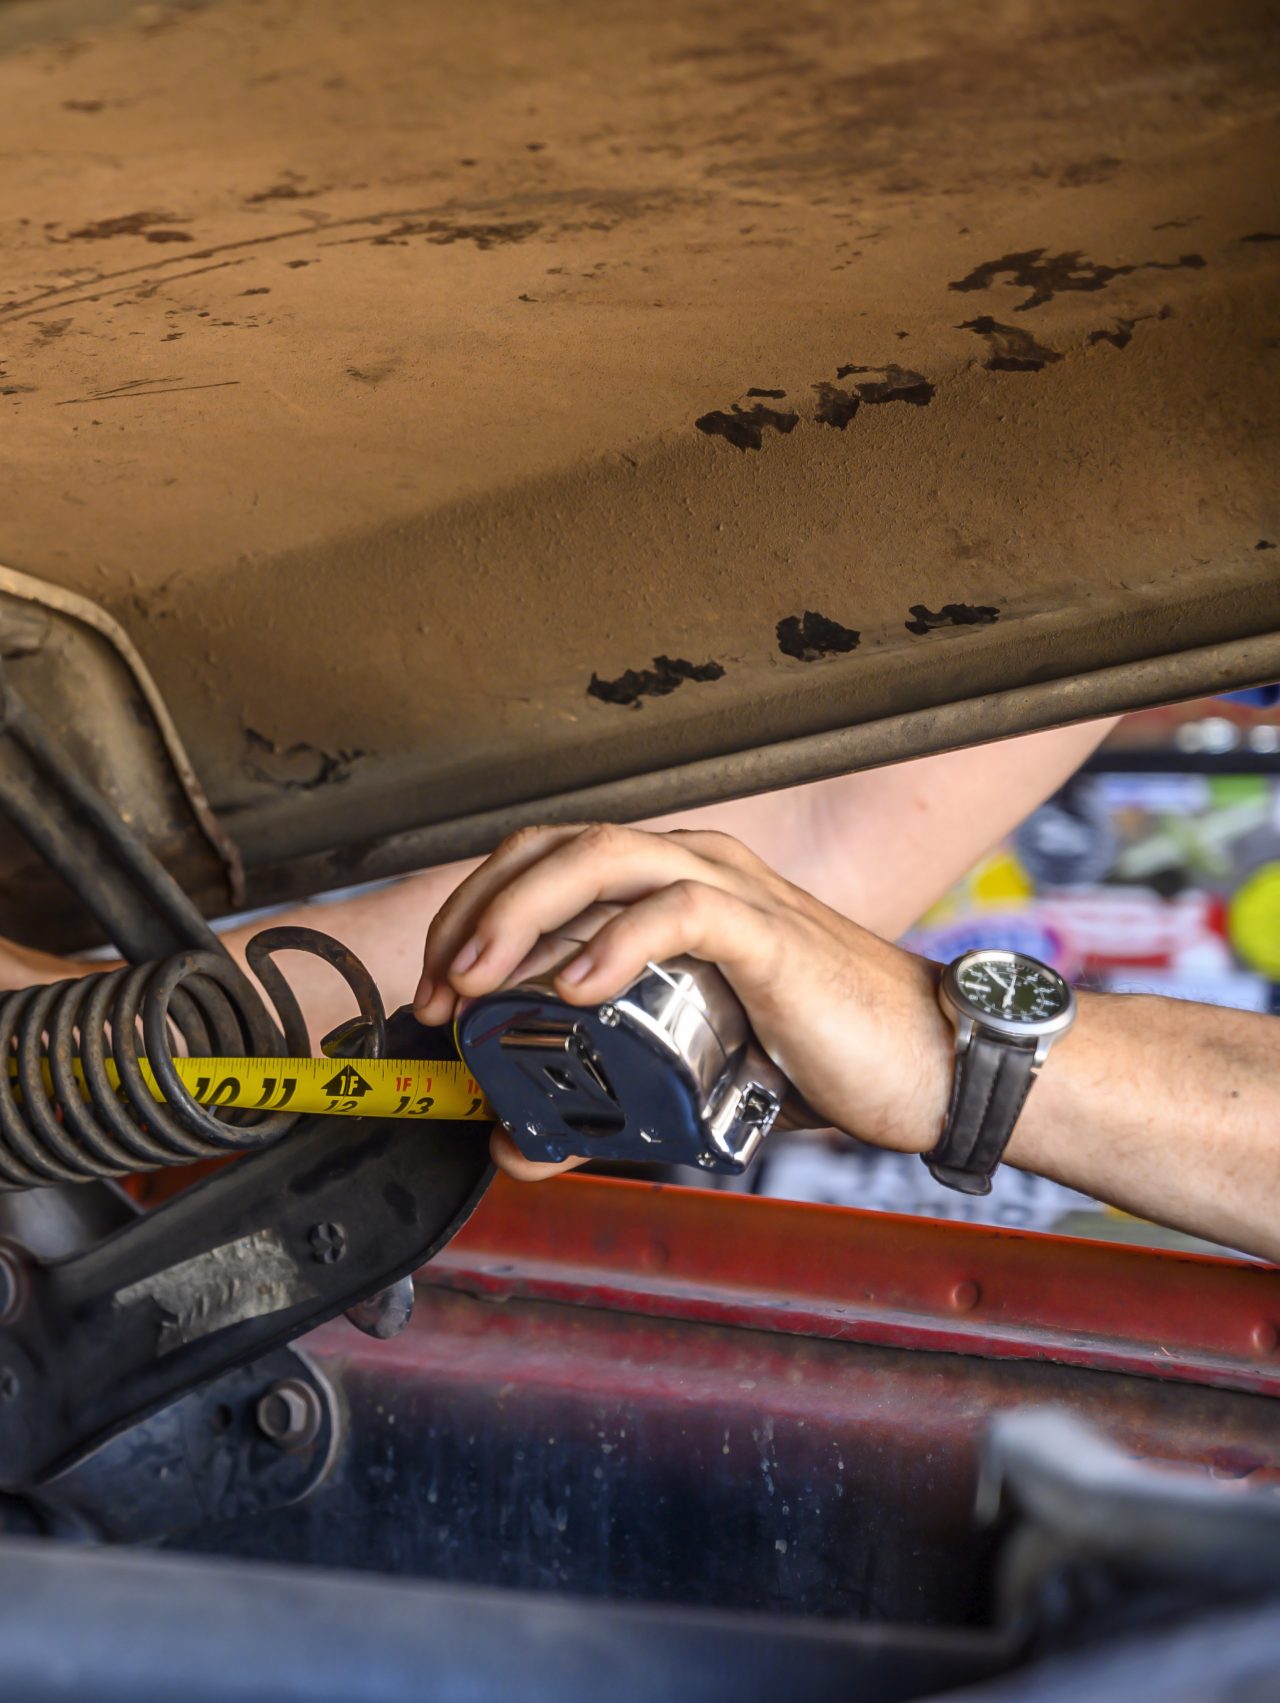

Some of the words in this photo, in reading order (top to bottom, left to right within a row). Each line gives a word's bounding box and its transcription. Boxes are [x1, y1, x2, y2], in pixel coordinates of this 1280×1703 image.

[193, 1077, 241, 1105] 10
[252, 1077, 298, 1109] 11
[395, 1077, 413, 1092] 1F
[425, 1077, 433, 1093] 1
[323, 1099, 358, 1113] 12
[391, 1096, 435, 1115] 13
